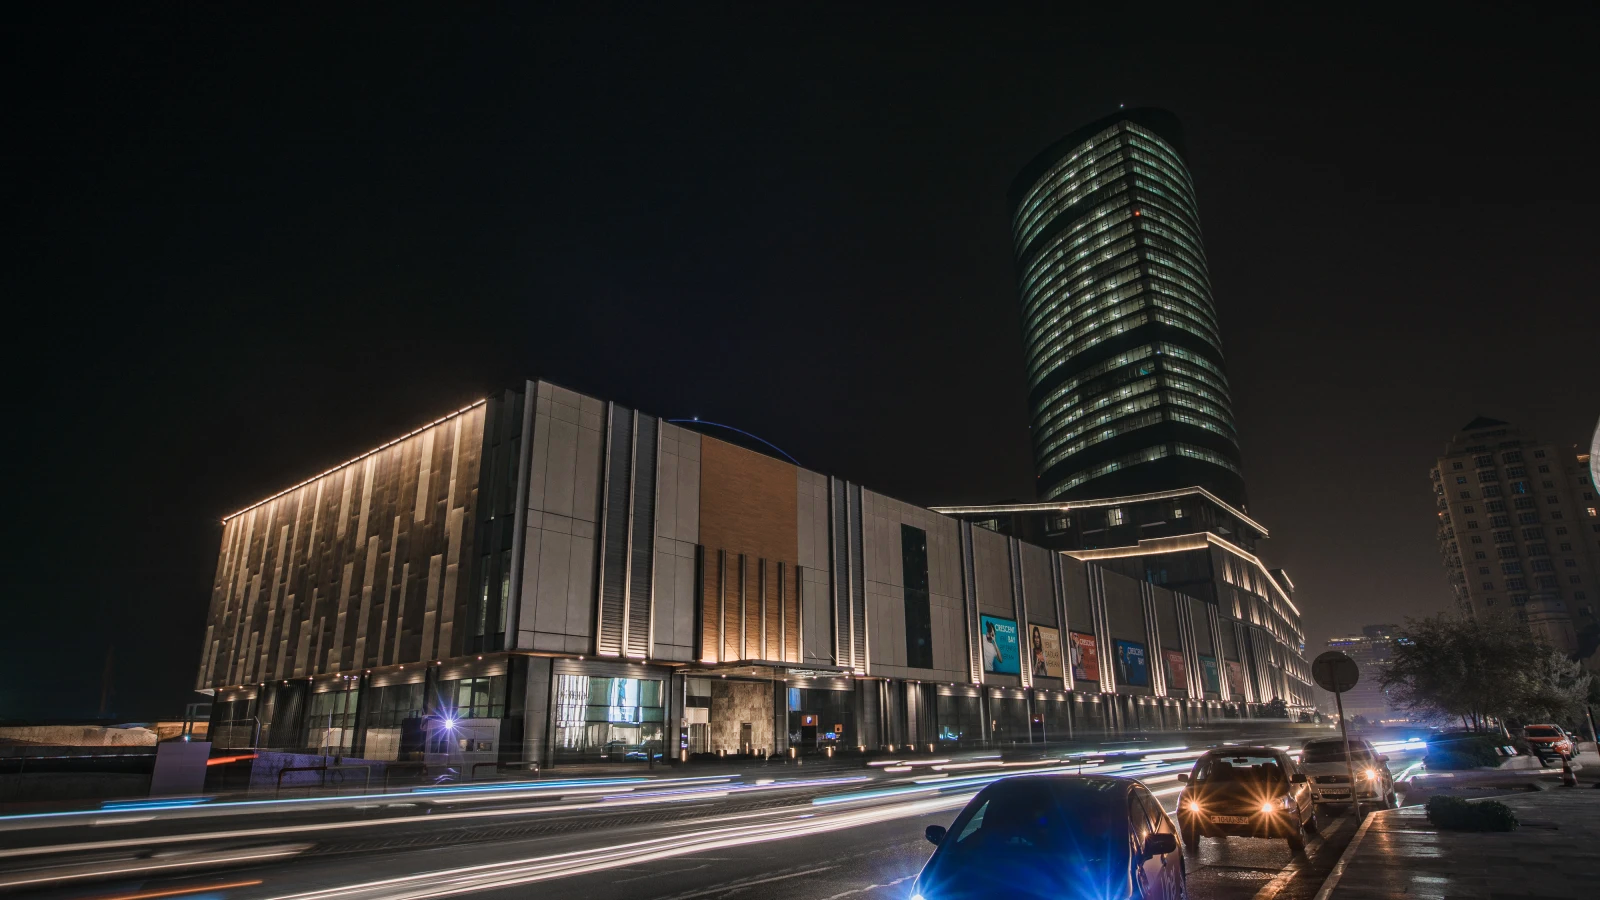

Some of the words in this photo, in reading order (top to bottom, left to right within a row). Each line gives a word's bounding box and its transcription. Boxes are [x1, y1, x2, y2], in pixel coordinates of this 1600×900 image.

[995, 624, 1015, 633] CRESCENT
[1008, 635, 1016, 644] BAY
[1080, 639, 1095, 647] CRESCENT
[1127, 647, 1143, 656] CRESCENT
